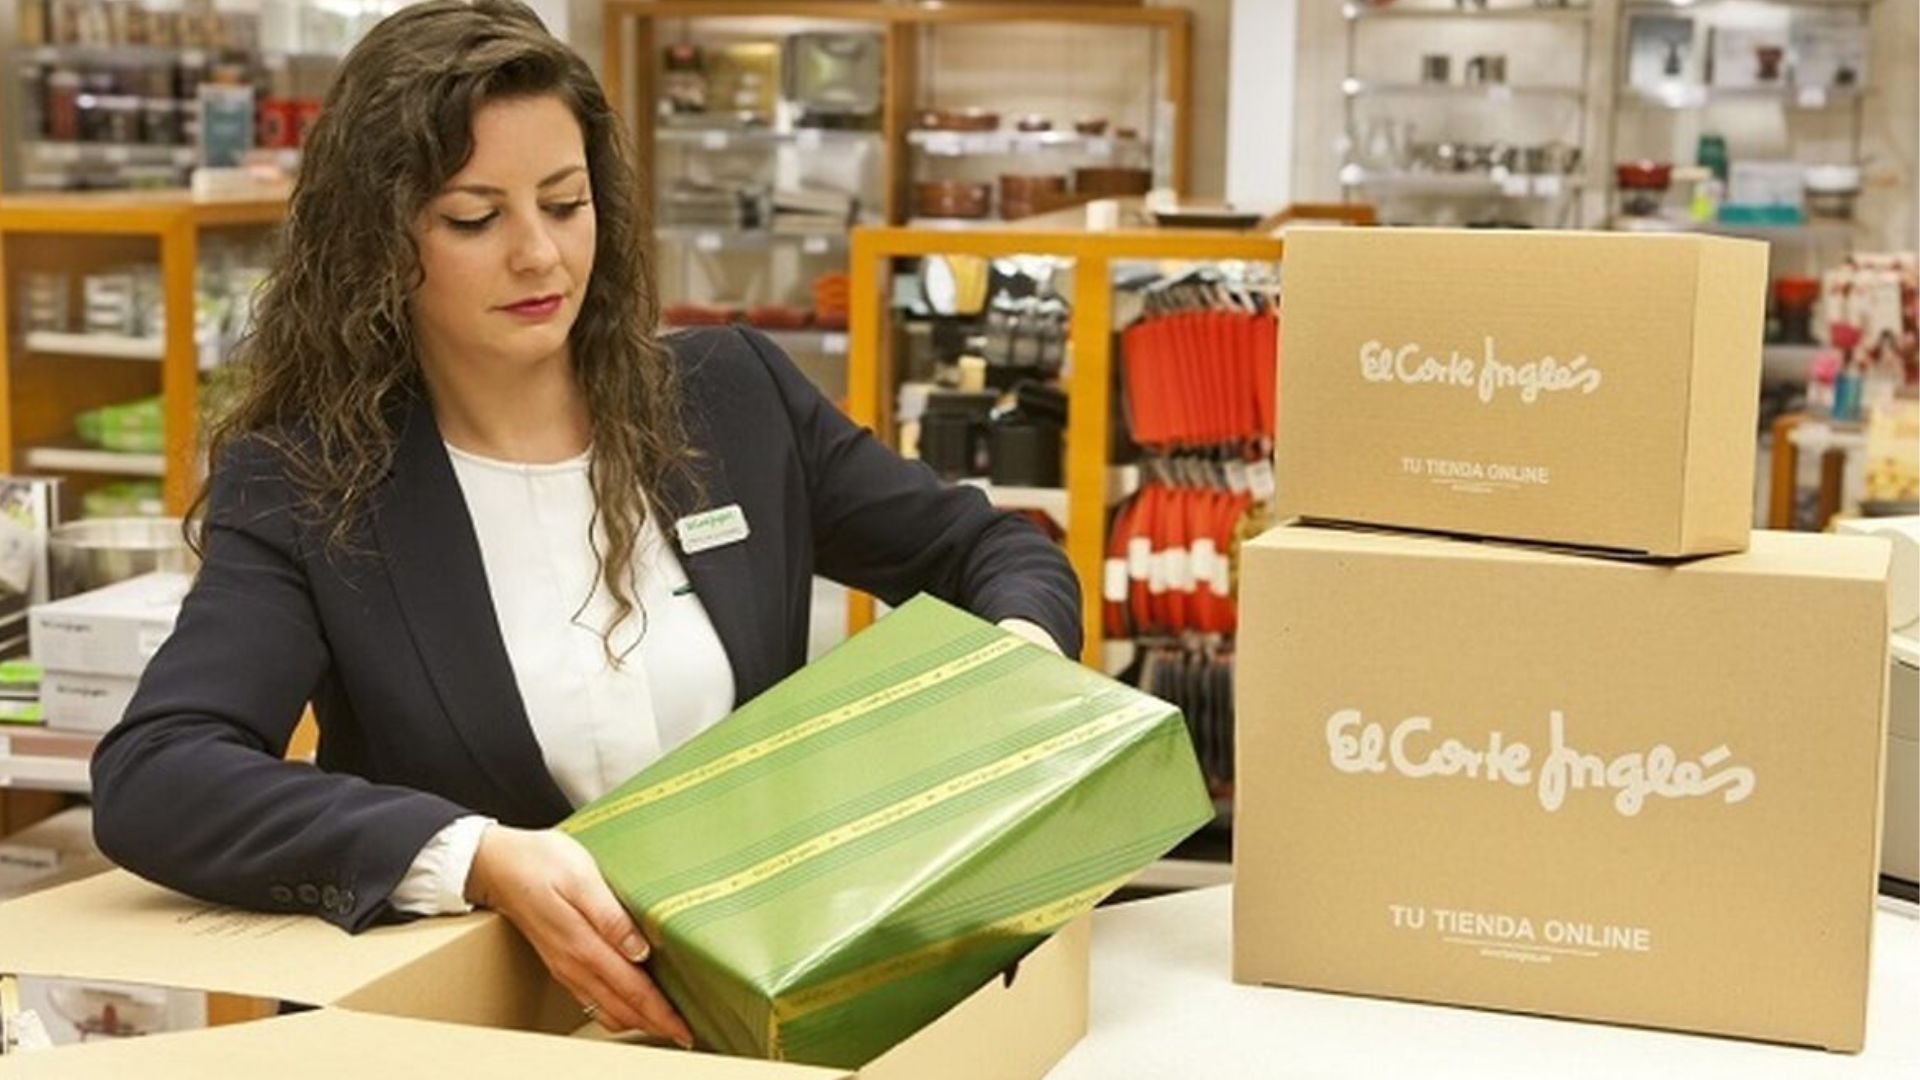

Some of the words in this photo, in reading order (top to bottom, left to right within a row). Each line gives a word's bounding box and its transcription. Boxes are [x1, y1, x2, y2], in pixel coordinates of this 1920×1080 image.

[1360, 340, 1394, 381] El
[1396, 342, 1475, 386] Corte
[1478, 335, 1602, 404] Inglés
[1401, 457, 1422, 474] TU
[1425, 459, 1485, 479] TIENDA
[1487, 463, 1550, 485] ONLINE
[1326, 709, 1386, 772] El
[1390, 716, 1532, 784] Corte
[1537, 710, 1756, 816] Inglés
[1388, 904, 1425, 928] TU
[1433, 909, 1535, 940] TIENDA
[1544, 919, 1651, 951] ONLINE
